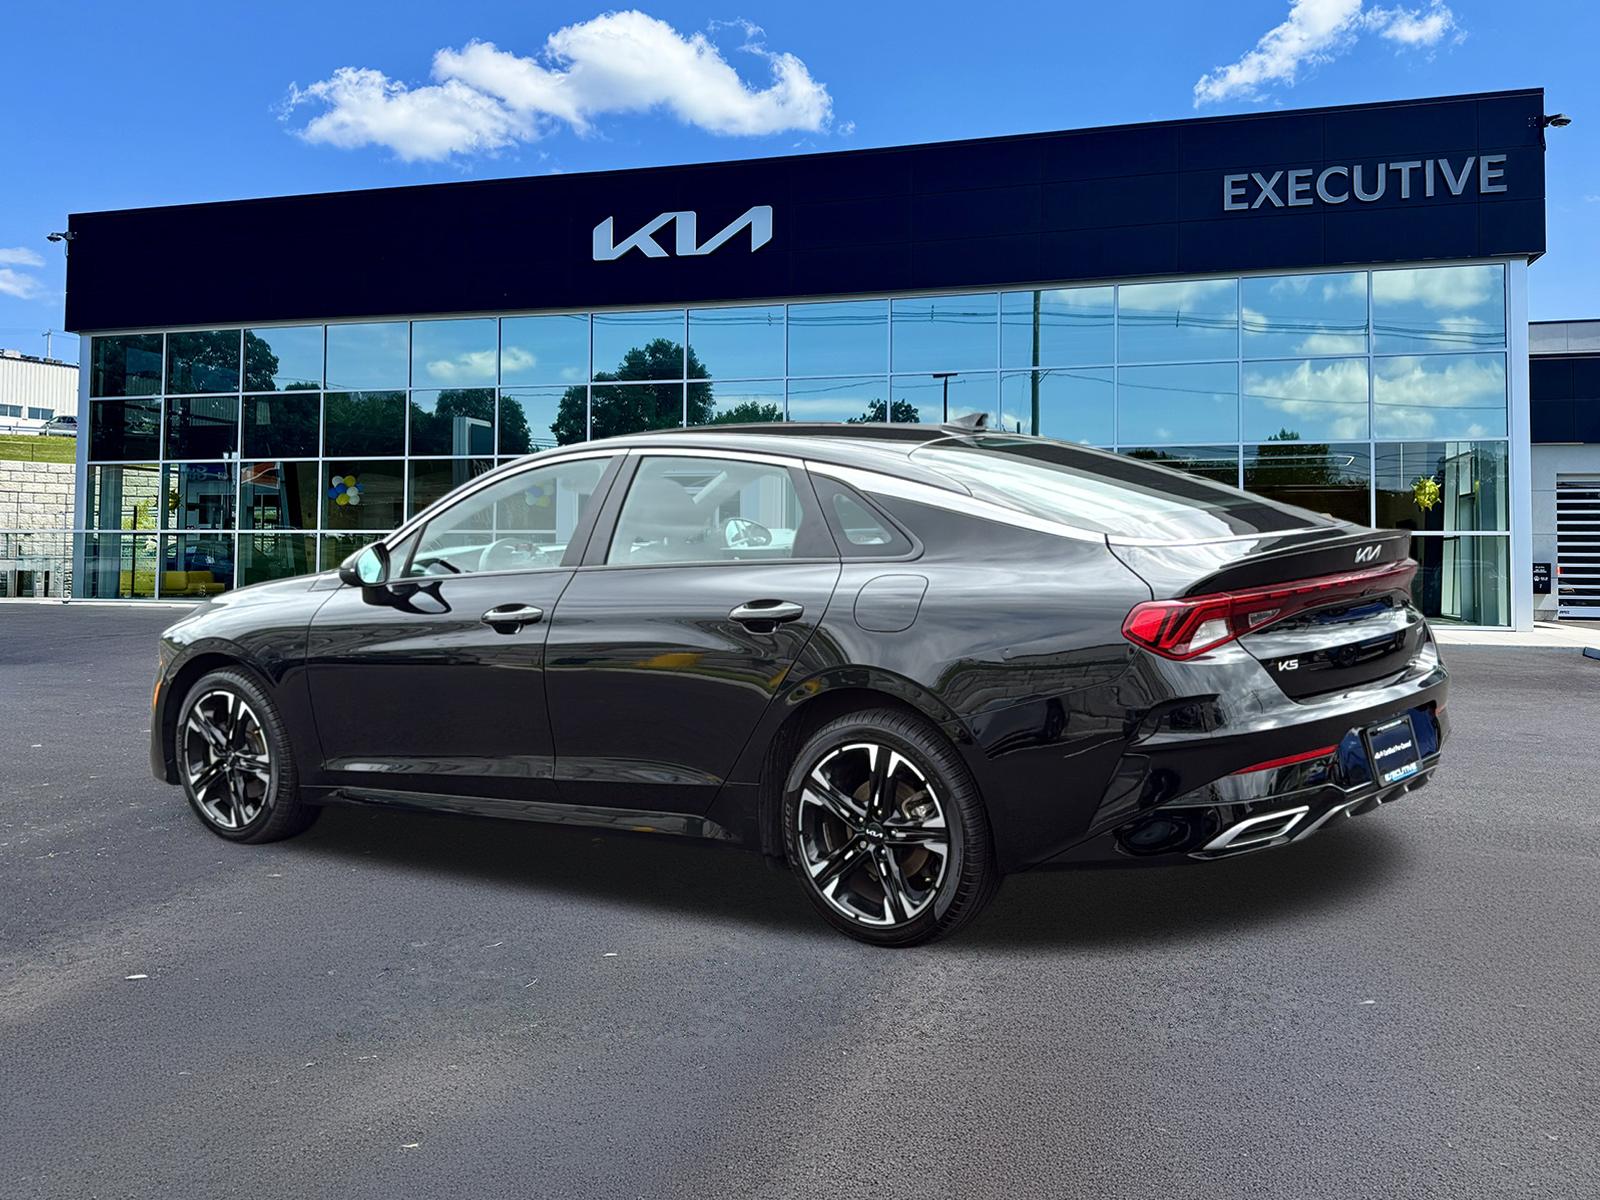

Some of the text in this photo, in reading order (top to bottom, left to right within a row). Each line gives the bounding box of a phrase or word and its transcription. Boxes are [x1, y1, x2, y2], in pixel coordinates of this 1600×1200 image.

[1223, 154, 1508, 211] EXECUTIVE
[593, 205, 773, 261] KIA
[1354, 544, 1382, 563] KIA
[1278, 659, 1299, 672] K5
